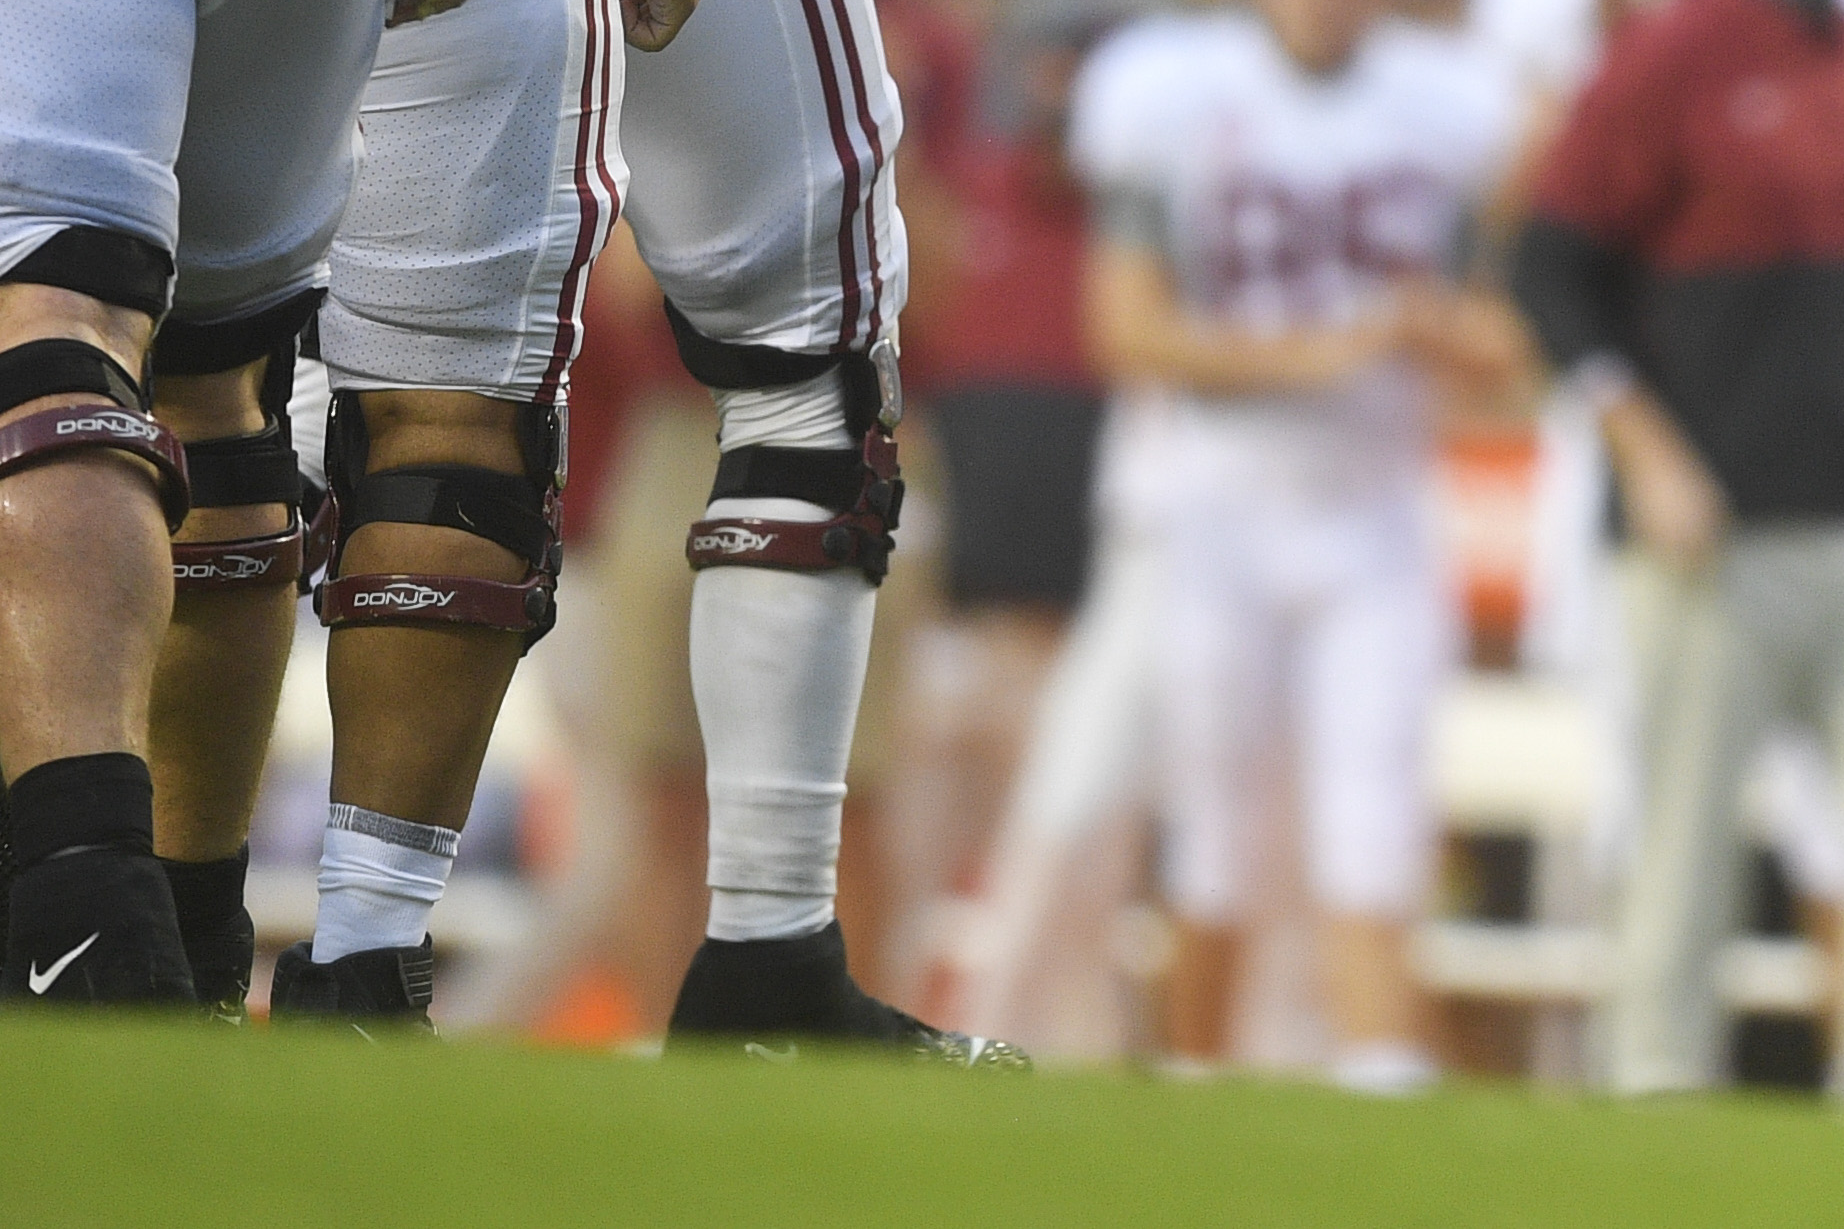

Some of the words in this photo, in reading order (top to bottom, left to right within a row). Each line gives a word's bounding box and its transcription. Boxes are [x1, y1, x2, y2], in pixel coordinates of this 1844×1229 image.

[55, 415, 160, 442] DONJOY
[693, 532, 776, 551] DONJOY
[353, 589, 456, 608] DONJOY
